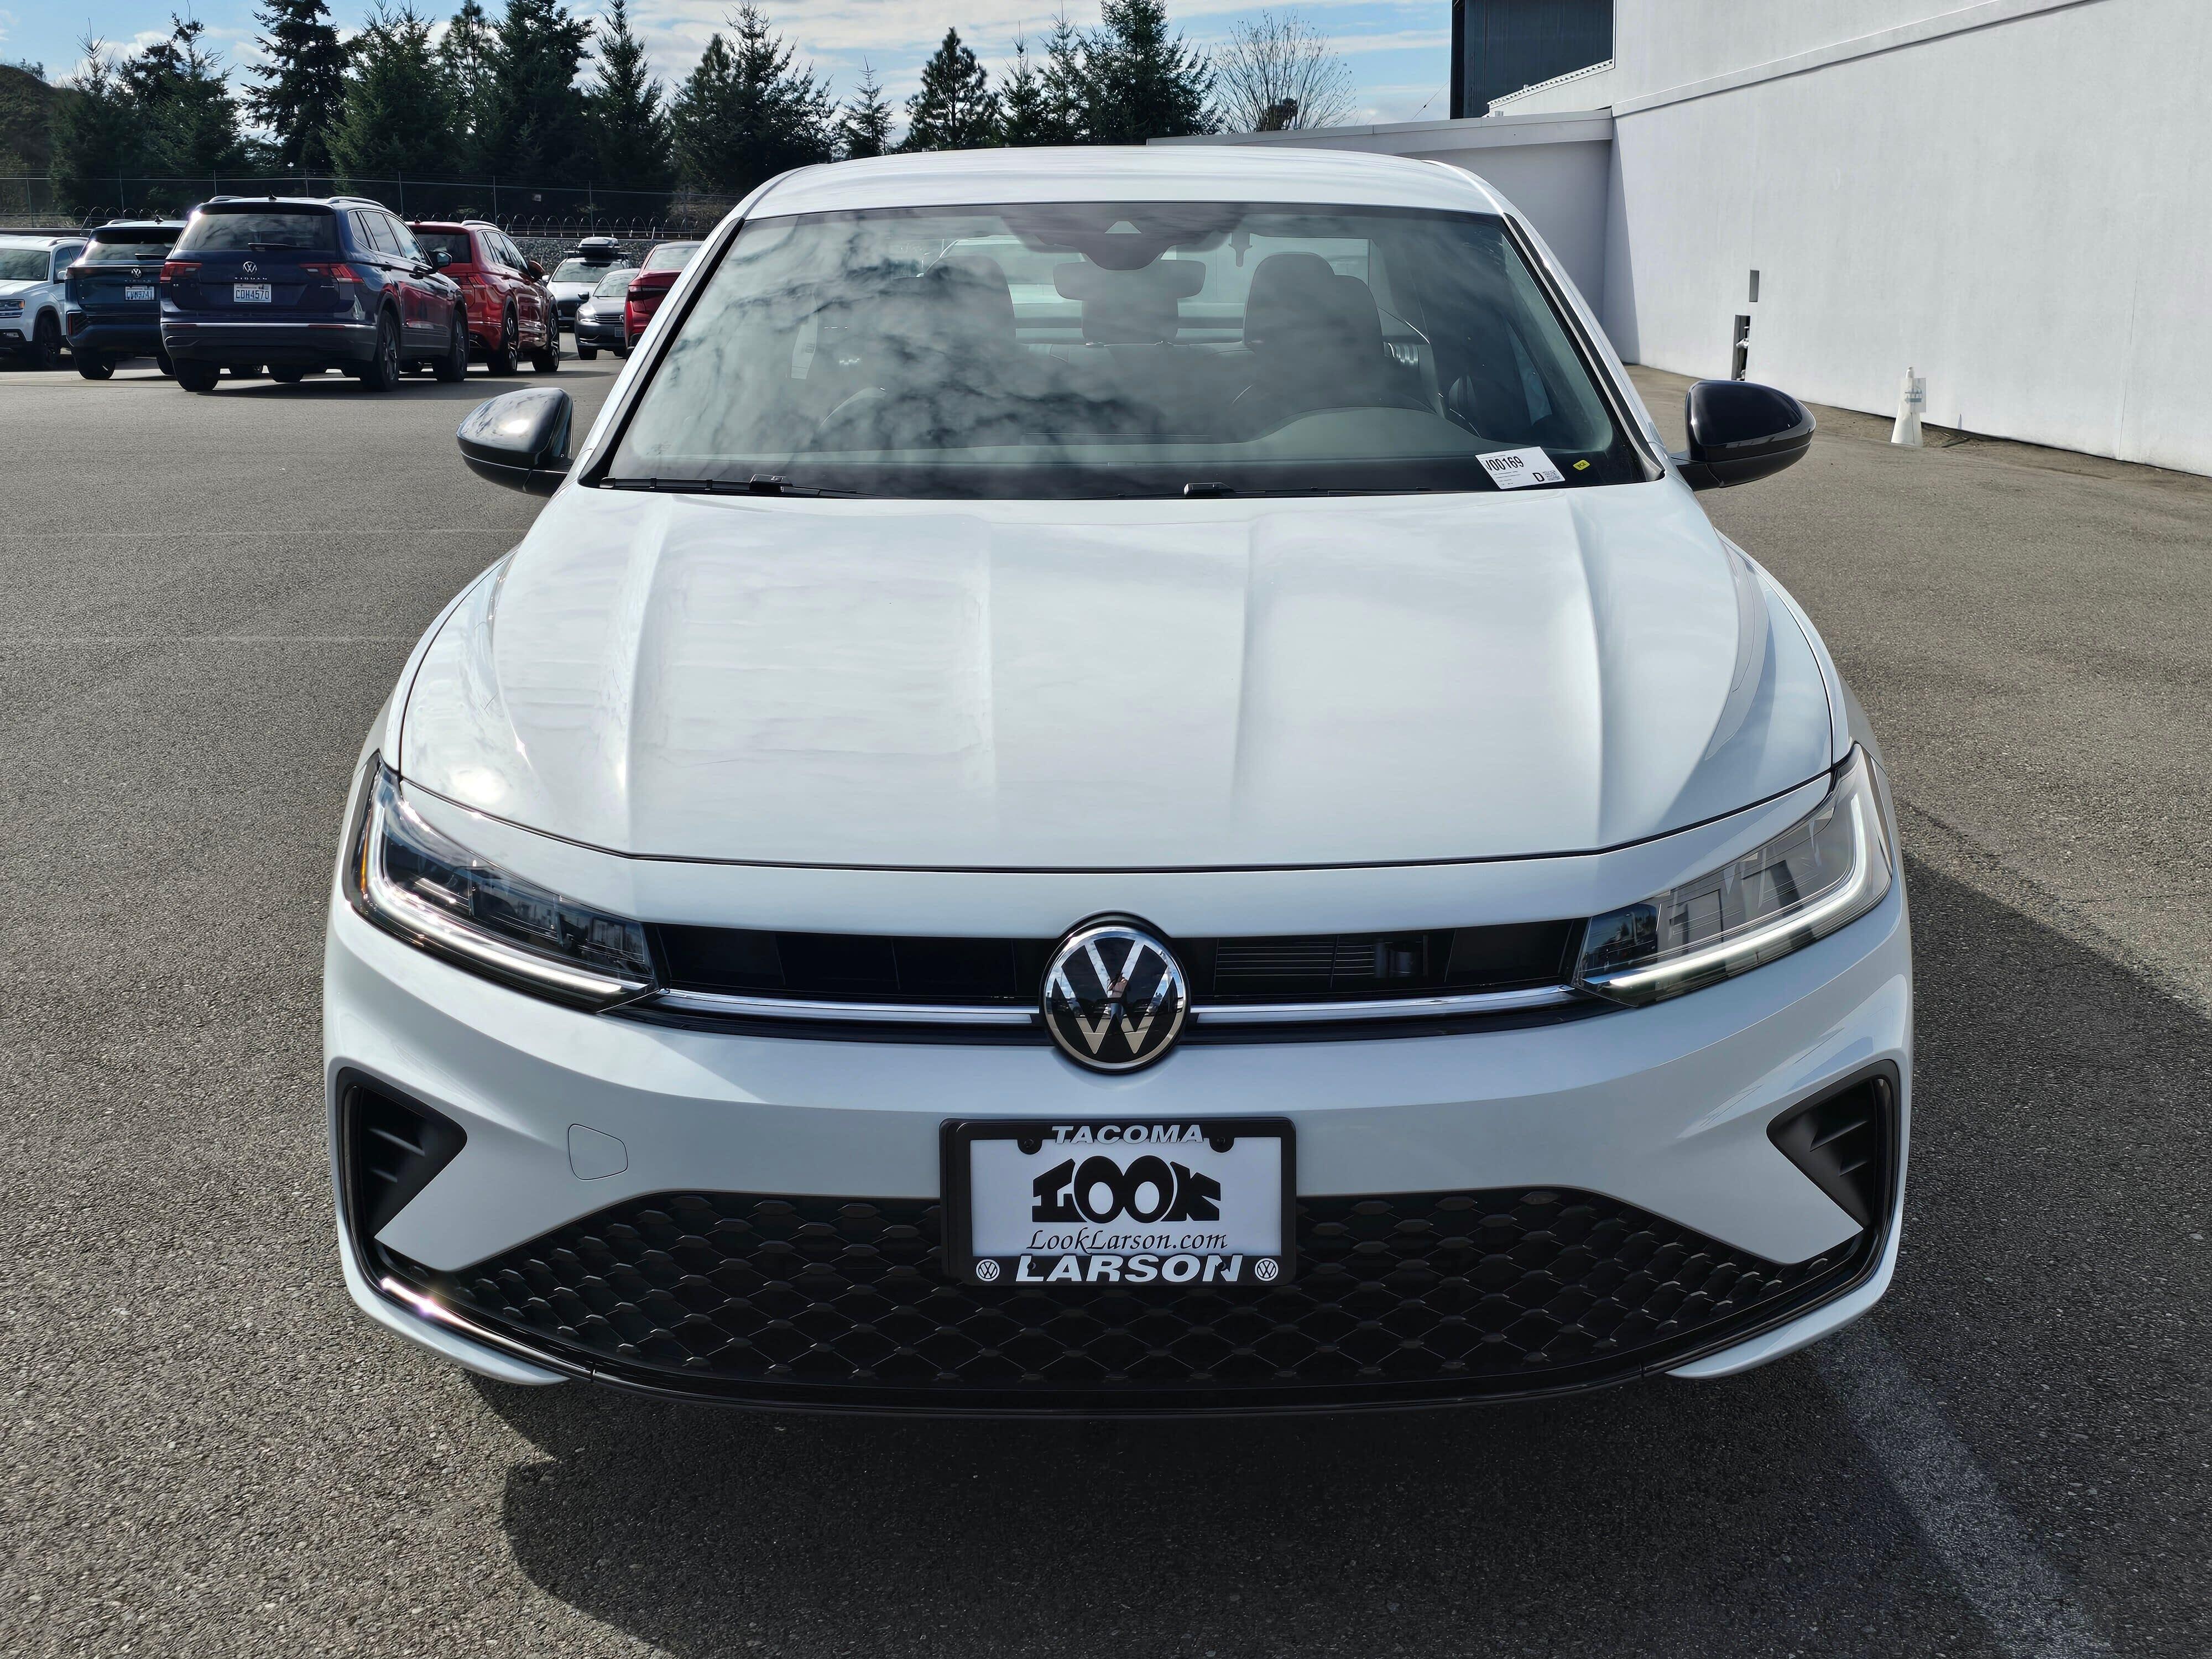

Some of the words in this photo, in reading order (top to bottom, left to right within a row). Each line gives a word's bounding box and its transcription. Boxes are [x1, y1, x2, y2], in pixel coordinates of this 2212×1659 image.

[236, 289, 269, 299] CDH4570
[1532, 472, 1545, 482] D
[1045, 926, 1186, 1070] VW
[1051, 1124, 1204, 1144] TACOMA
[1032, 1155, 1221, 1223] LOOK
[1026, 1227, 1228, 1254] LookLarson.com
[976, 1259, 1000, 1282] VW
[1015, 1254, 1243, 1283] LARSON
[1255, 1258, 1279, 1282] VW
